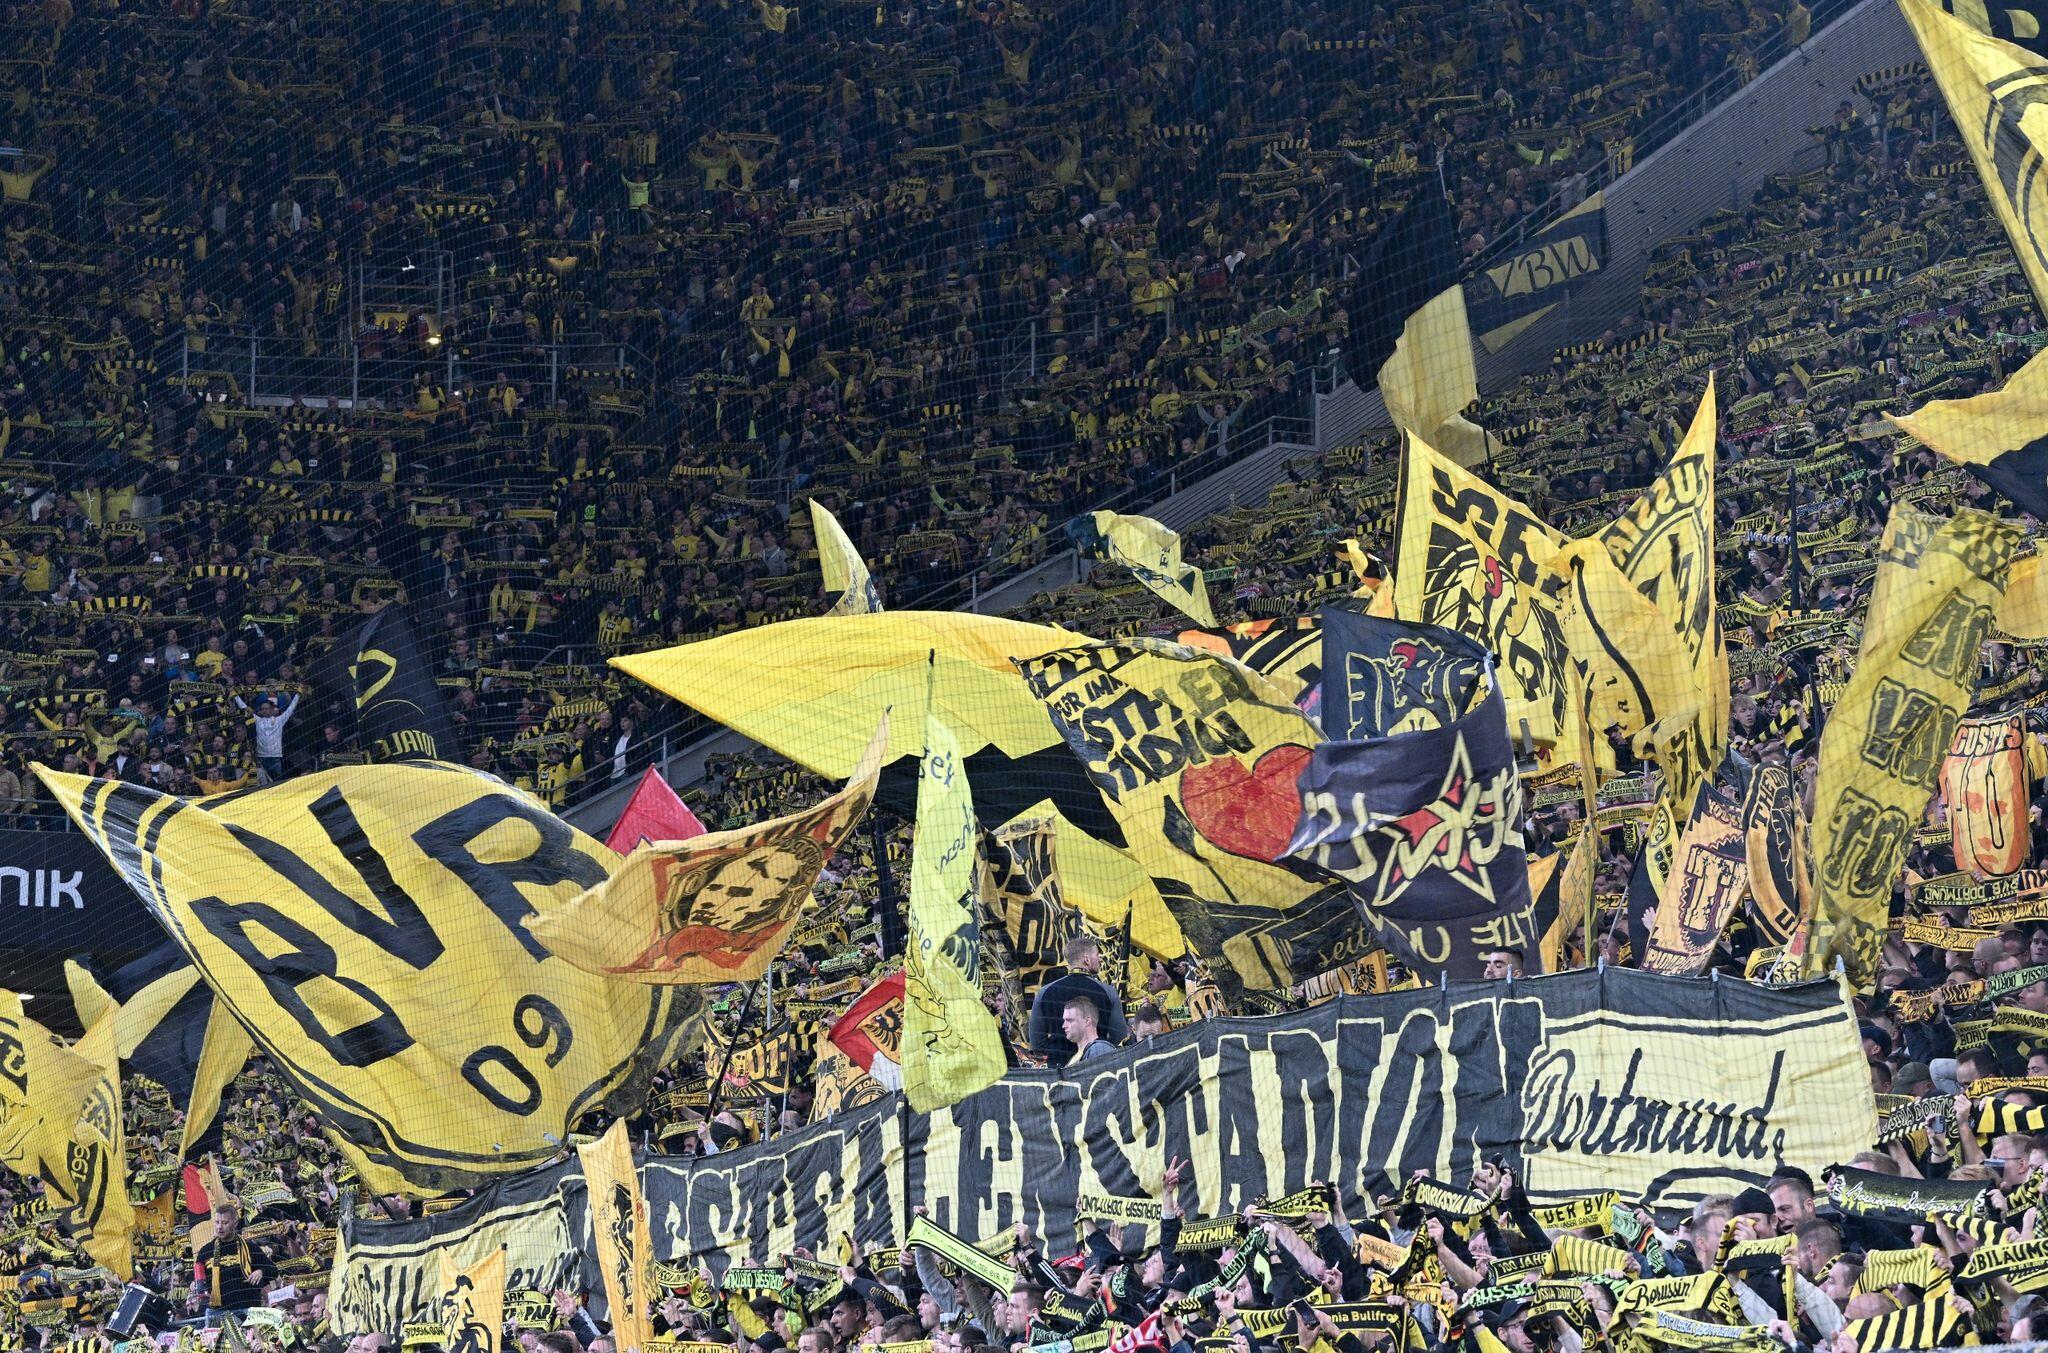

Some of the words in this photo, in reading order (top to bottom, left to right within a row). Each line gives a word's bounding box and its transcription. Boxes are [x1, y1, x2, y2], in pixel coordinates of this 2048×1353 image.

[460, 993, 573, 1118] 09
[1520, 1045, 1787, 1162] Dortmund
[1416, 1183, 1465, 1213] BORUSSIA
[1846, 1181, 1896, 1209] Borussia
[1896, 1191, 1968, 1213] Dortmund
